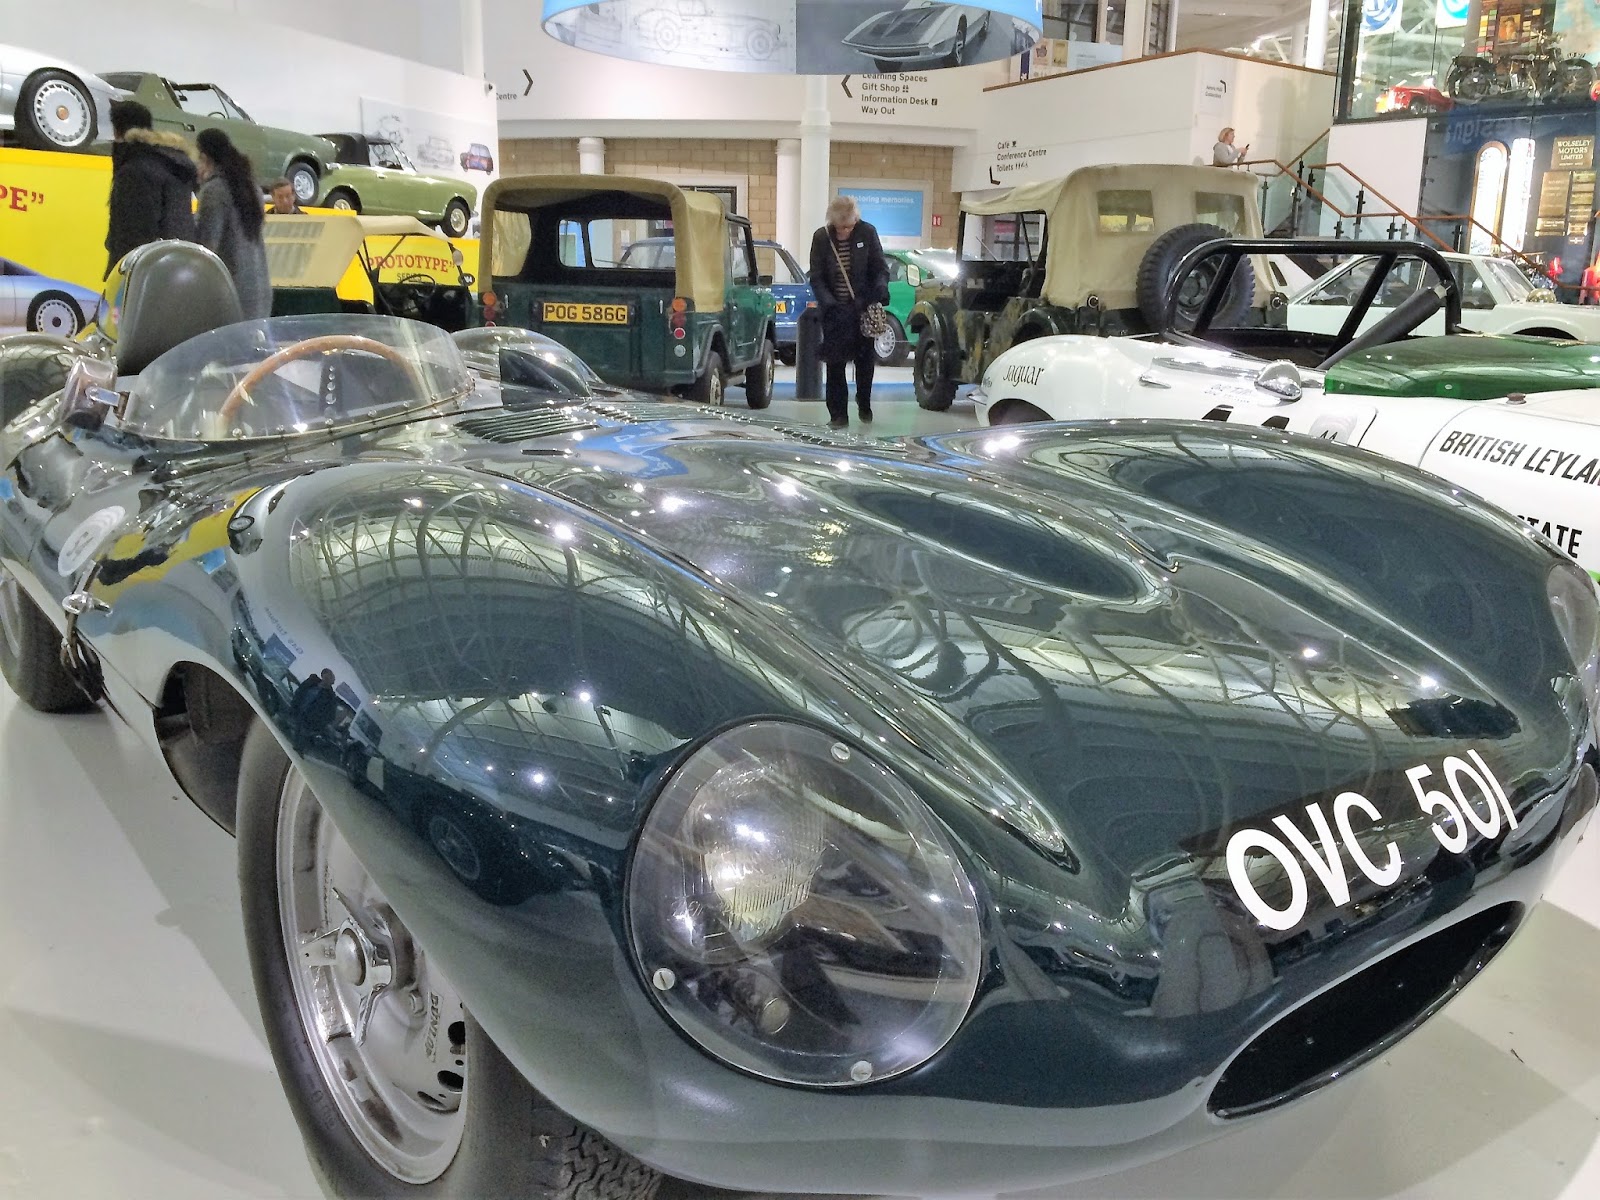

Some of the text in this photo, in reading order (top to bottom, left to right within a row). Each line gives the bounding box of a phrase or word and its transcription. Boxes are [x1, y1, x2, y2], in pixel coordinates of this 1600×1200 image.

[899, 73, 928, 83] Spaces
[861, 82, 900, 93] Gift Shop
[861, 94, 929, 105] Information Desk
[861, 105, 895, 115] Way Out
[1557, 139, 1592, 147] WOLSELEY
[996, 149, 1047, 161] Conference Centre
[1558, 146, 1589, 154] MOTORS
[996, 164, 1014, 172] Toilets
[544, 304, 626, 322] POG 586G
[1438, 430, 1528, 467] BRITISH
[1517, 514, 1582, 559] TATE
[1226, 749, 1518, 931] OVC 501
